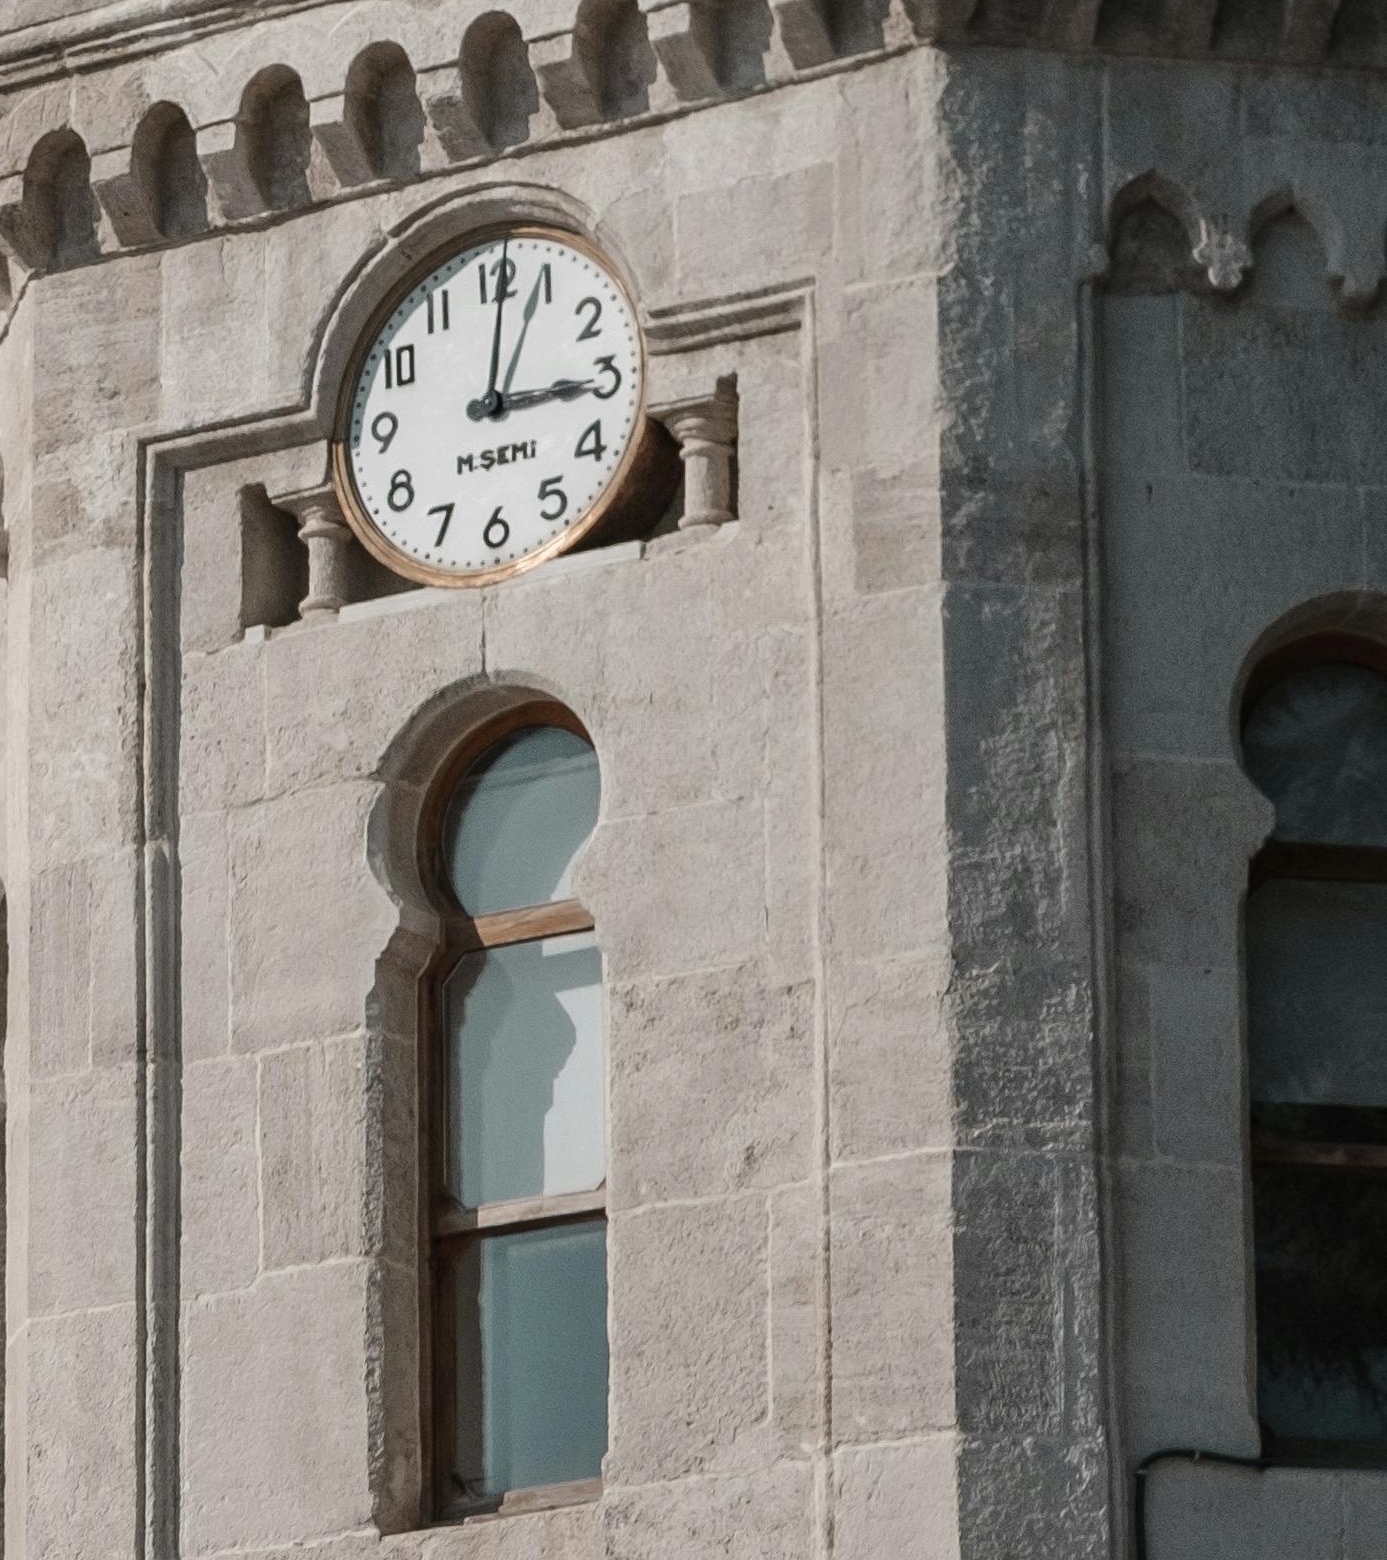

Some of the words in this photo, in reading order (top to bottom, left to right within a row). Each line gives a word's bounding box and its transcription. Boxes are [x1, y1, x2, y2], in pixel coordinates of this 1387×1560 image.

[427, 288, 450, 335] 11
[574, 296, 603, 342] 2
[384, 343, 416, 390] 10
[592, 355, 622, 400] 3
[371, 411, 400, 454] 9
[575, 419, 608, 462] 4
[387, 469, 415, 513] 8
[538, 475, 568, 521] 5
[427, 503, 456, 547] 7
[483, 506, 511, 549] 6
